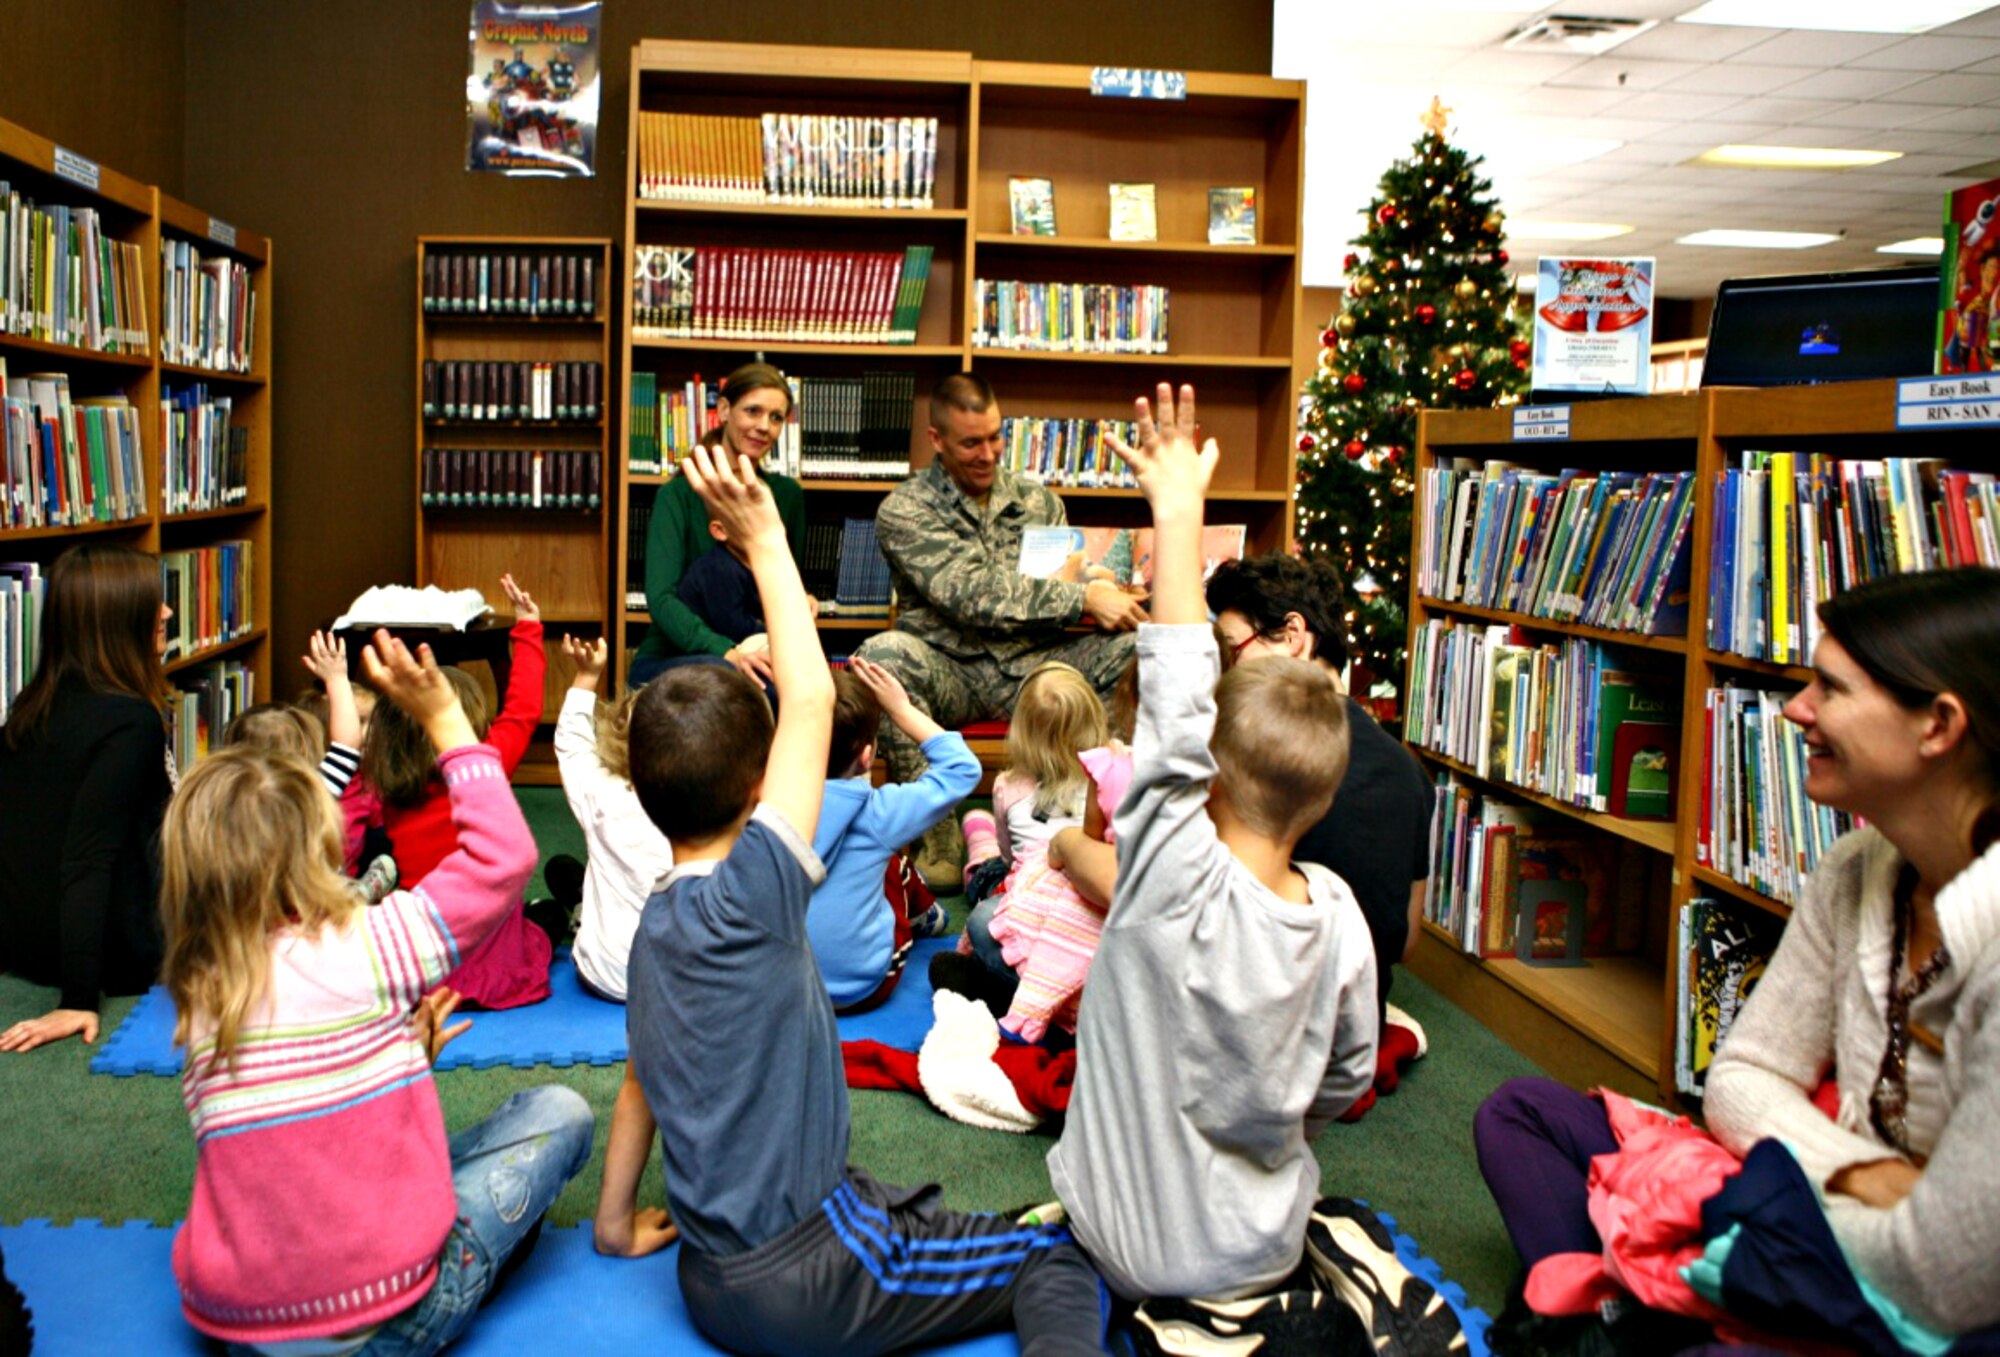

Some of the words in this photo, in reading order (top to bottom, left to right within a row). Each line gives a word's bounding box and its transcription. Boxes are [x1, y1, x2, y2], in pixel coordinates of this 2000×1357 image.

[483, 20, 538, 46] Graphic
[543, 21, 589, 44] Novels
[762, 115, 889, 152] WORLD
[1929, 383, 1955, 400] Easy
[1961, 380, 1990, 395] Book
[1927, 406, 1951, 420] RIN
[1962, 403, 1990, 419] SAN
